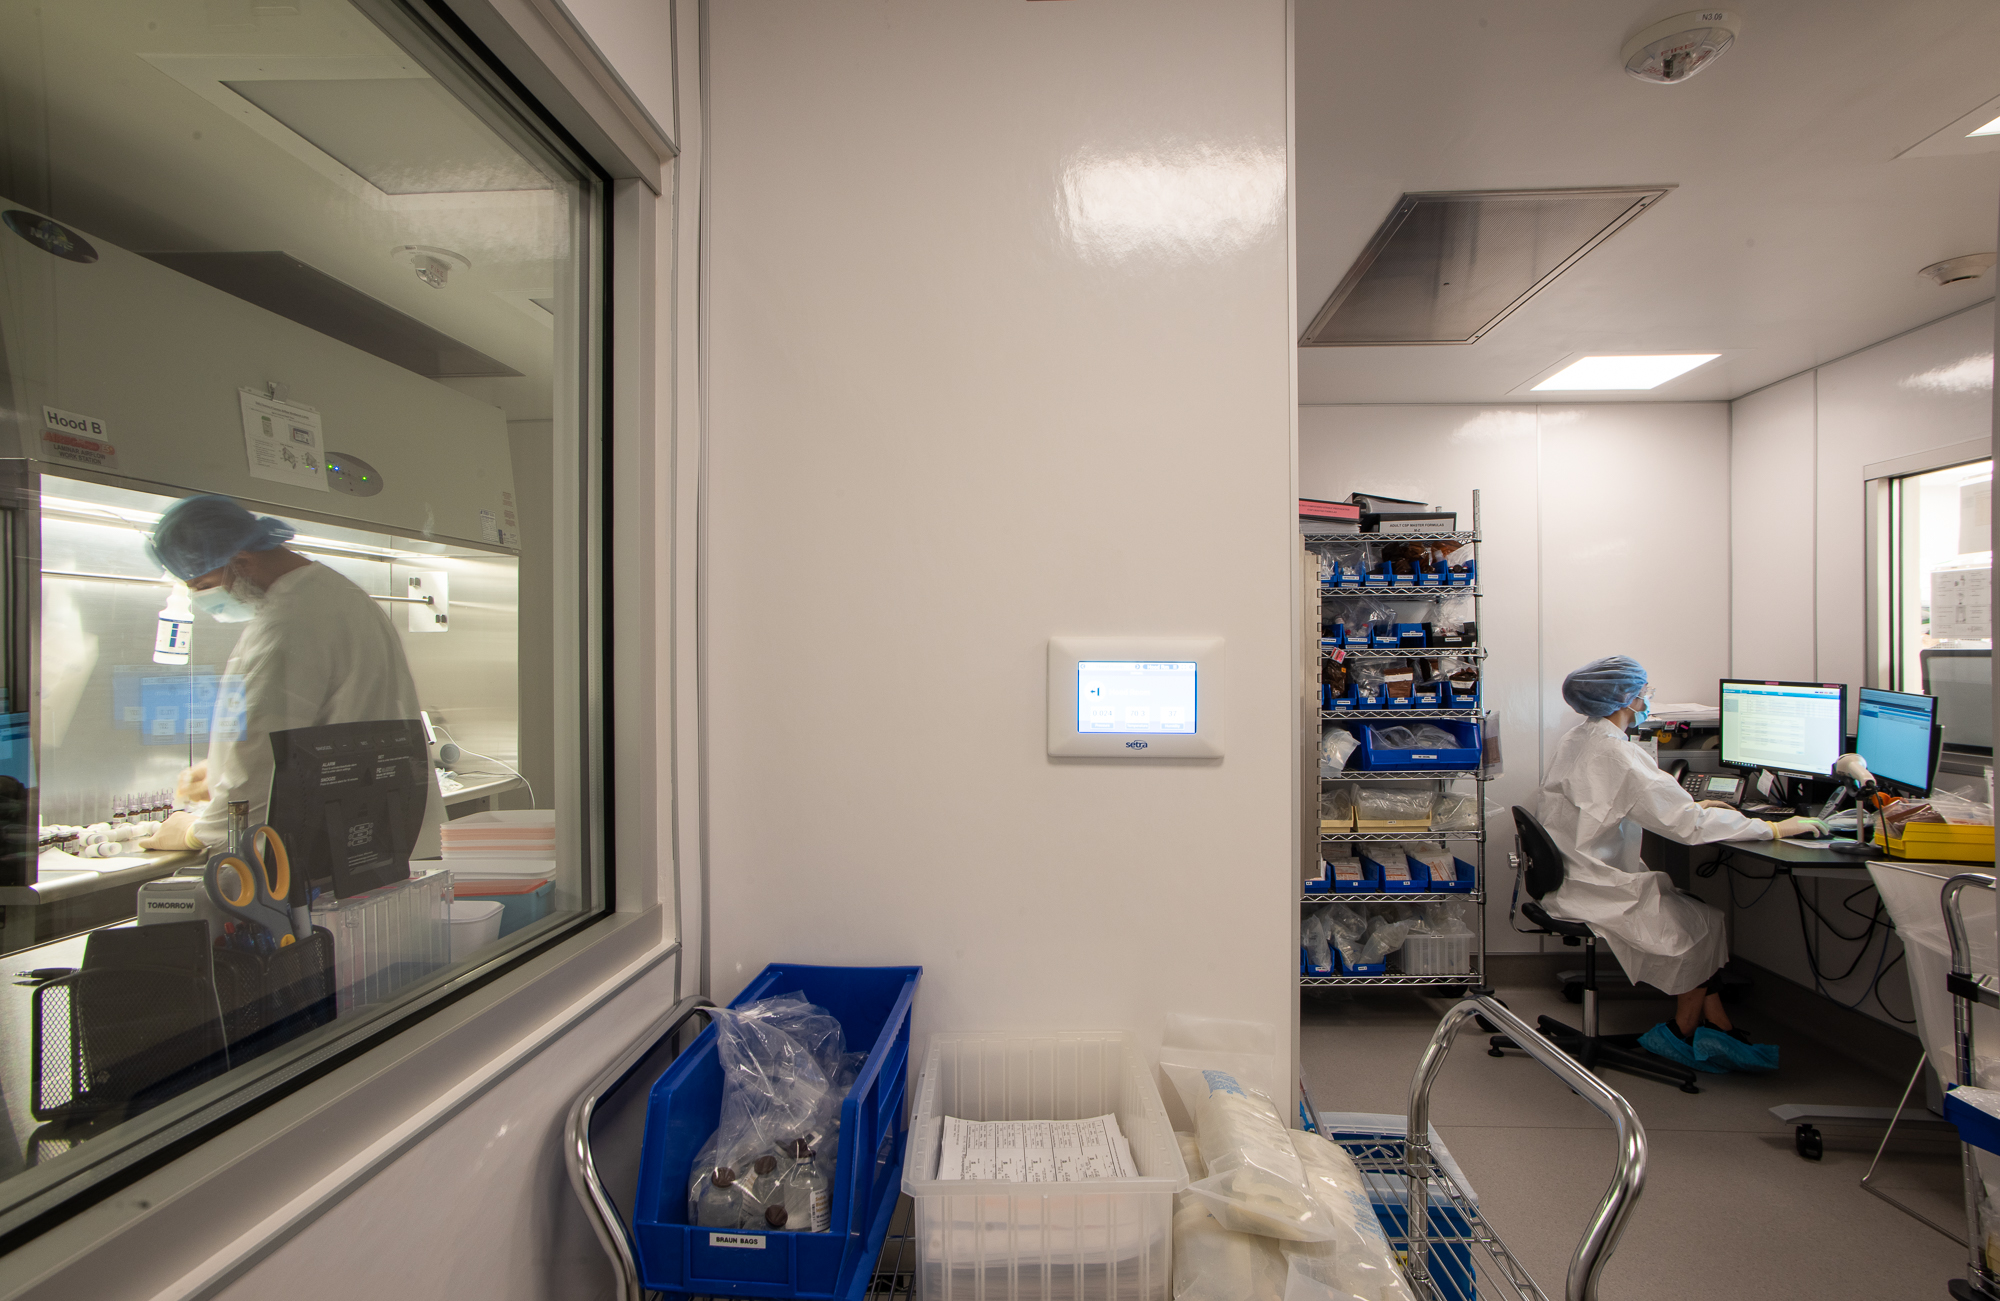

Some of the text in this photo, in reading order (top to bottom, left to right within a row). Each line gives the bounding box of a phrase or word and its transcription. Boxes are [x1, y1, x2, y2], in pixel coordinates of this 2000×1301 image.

[1702, 13, 1723, 21] N3.09
[1660, 42, 1695, 57] FIRE
[430, 264, 444, 278] FIRE
[47, 410, 102, 435] Hood B
[53, 444, 106, 460] LAMINAR AIRFLOW
[59, 451, 102, 465] WORK STATION
[1125, 740, 1148, 750] setra
[147, 901, 195, 910] TOMORROW
[715, 1236, 738, 1244] BRAUN
